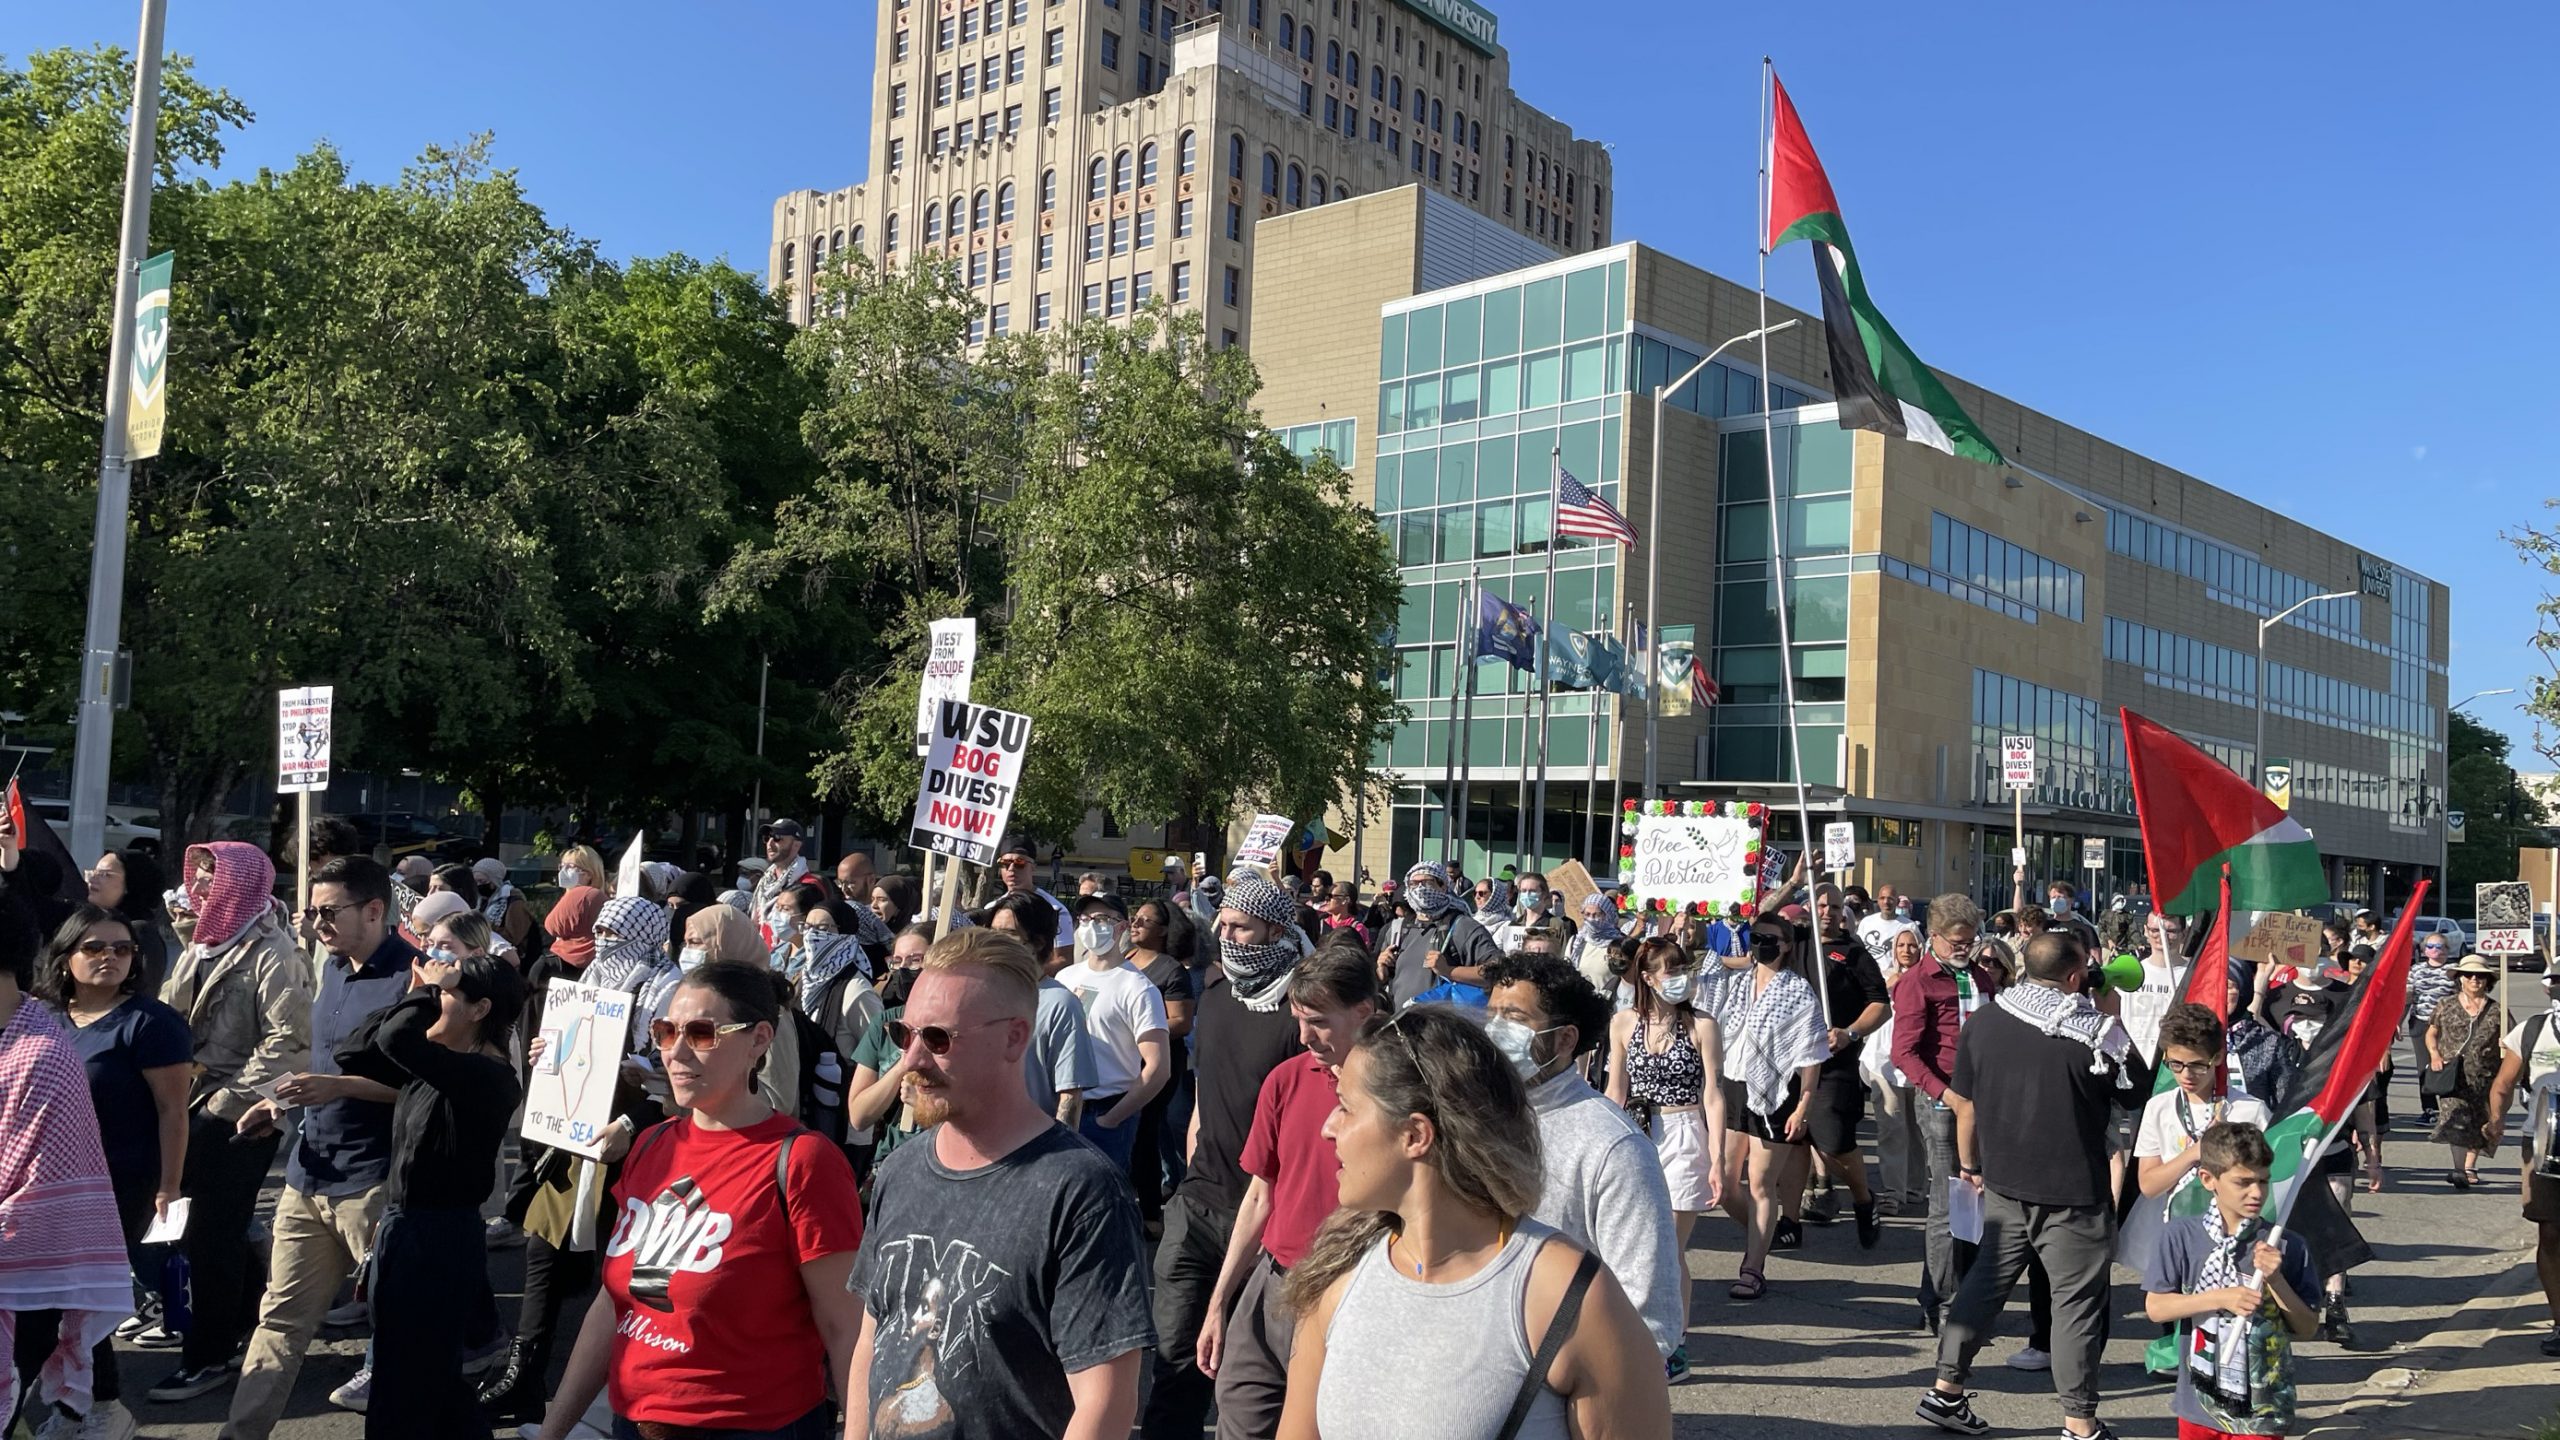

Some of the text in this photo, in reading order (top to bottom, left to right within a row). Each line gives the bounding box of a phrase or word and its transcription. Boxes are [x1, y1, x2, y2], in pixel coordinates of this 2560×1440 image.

[1420, 0, 1495, 44] NIVERSITY
[934, 647, 955, 660] FROM
[282, 697, 329, 708] FROM PALESTINE
[282, 706, 329, 718] TO PHILIPPINES
[282, 722, 297, 731] STOP
[942, 700, 1028, 753] WSU
[284, 736, 295, 744] THE
[2004, 737, 2033, 750] WSU
[282, 760, 328, 772] WAR MACHINE
[951, 744, 1001, 777] BOG
[2005, 760, 2032, 769] DIVEST
[2010, 751, 2027, 760] BOG
[2008, 771, 2030, 780] NOW!
[927, 769, 1011, 810] DIVEST
[2045, 784, 2116, 812] WELCOME
[929, 800, 996, 837] NOW!
[931, 834, 983, 860] SJP WSU
[1641, 827, 1690, 854] Free
[1642, 857, 1729, 887] Palestine
[2480, 938, 2529, 951] GAZA
[2490, 930, 2519, 939] SAVE
[548, 984, 600, 1010] FROM THE
[595, 1001, 625, 1020] RIVER
[530, 1111, 595, 1143] TO THE SEA
[606, 1197, 733, 1274] DWB
[869, 1233, 1012, 1364] DMX
